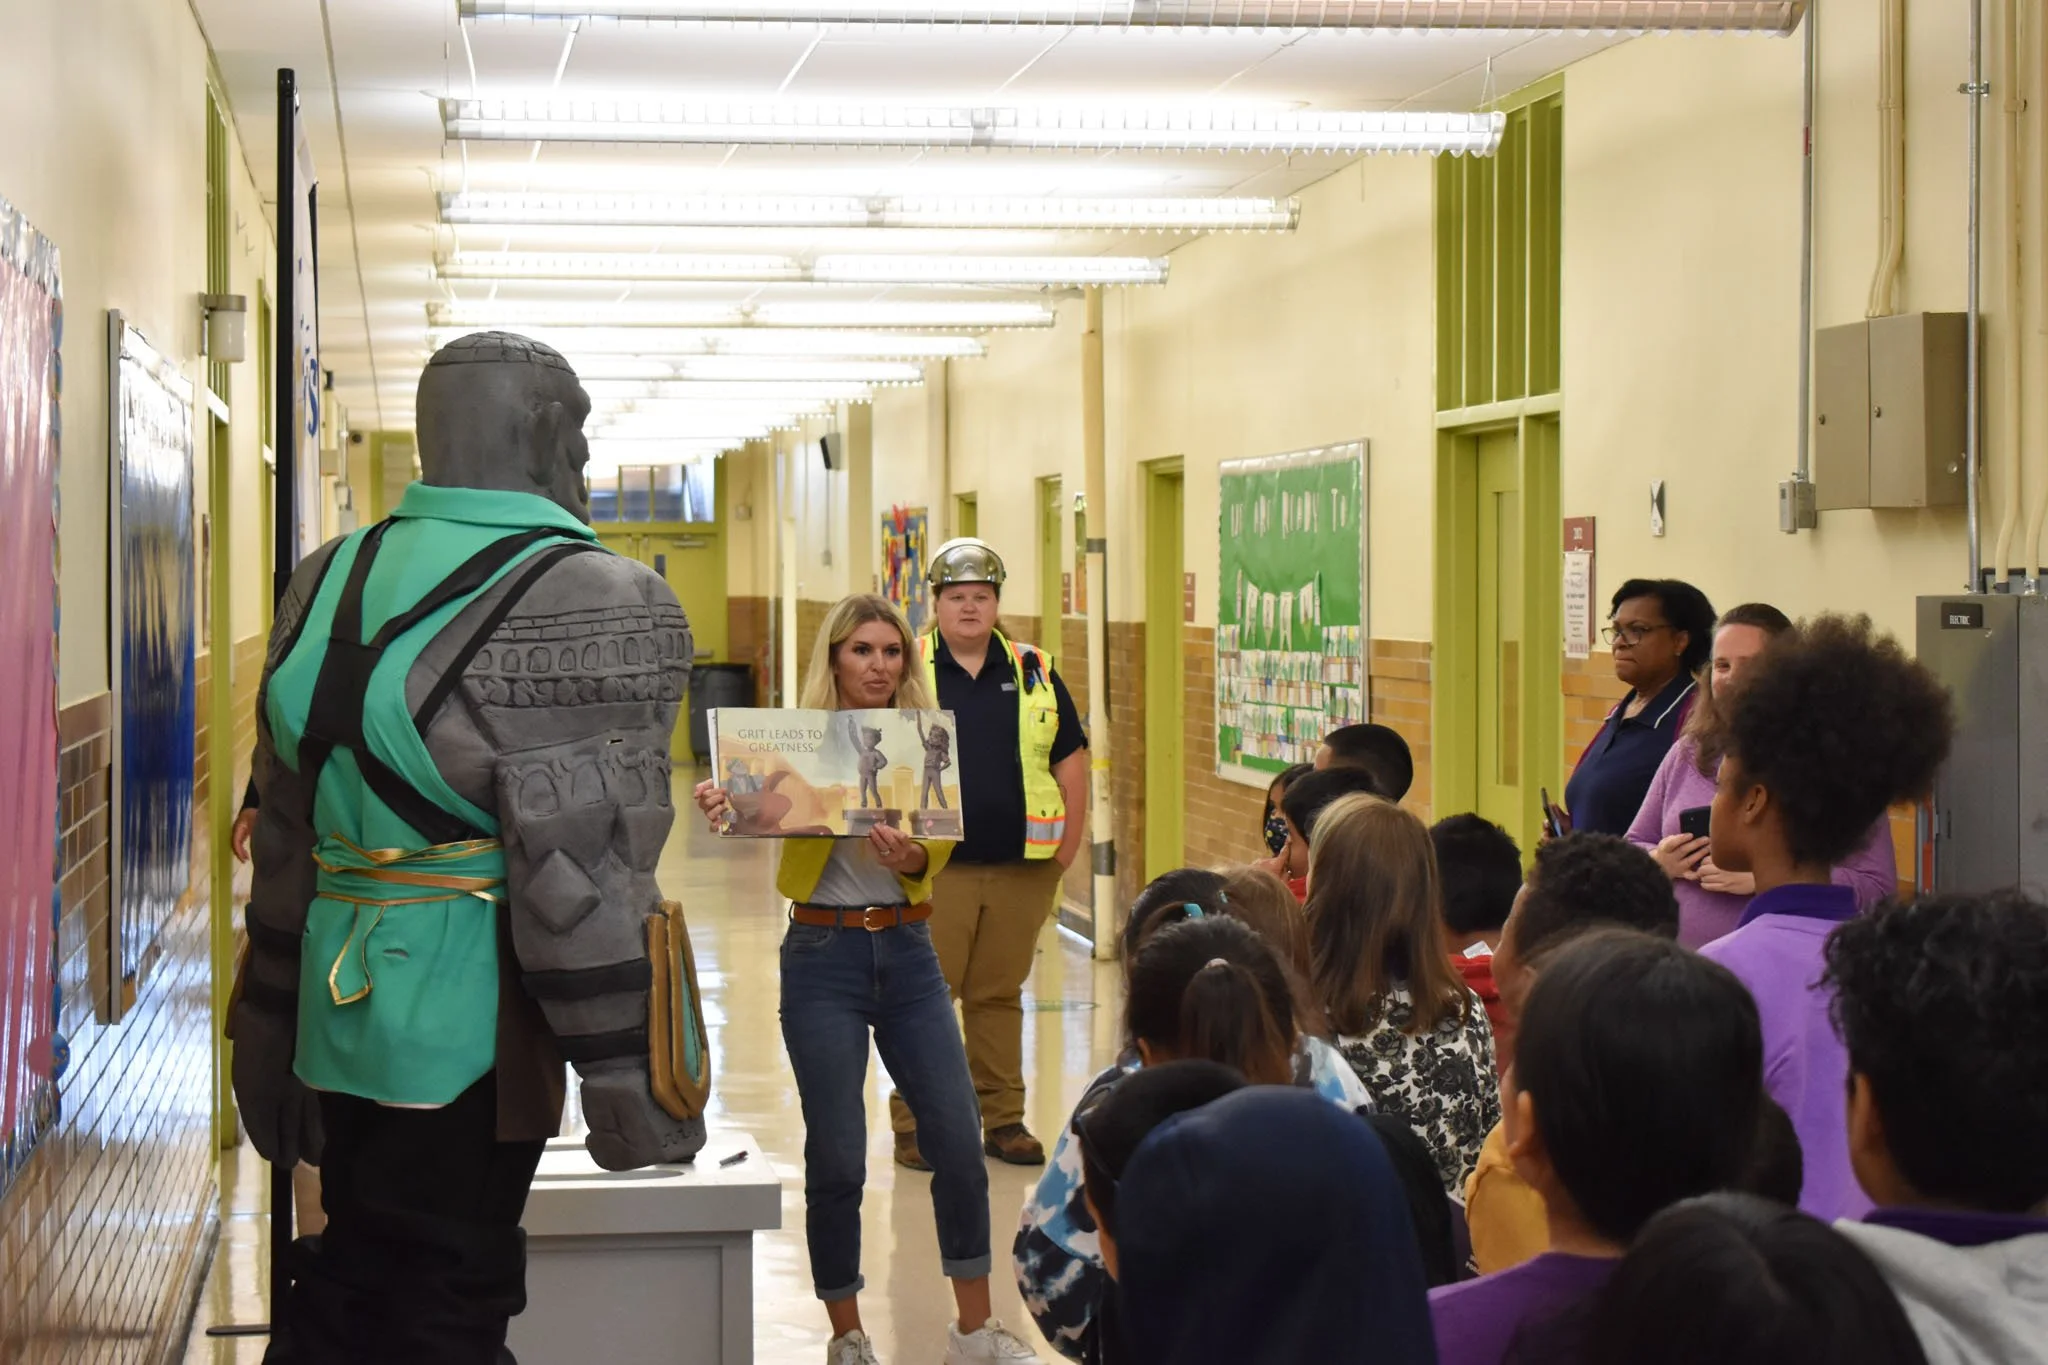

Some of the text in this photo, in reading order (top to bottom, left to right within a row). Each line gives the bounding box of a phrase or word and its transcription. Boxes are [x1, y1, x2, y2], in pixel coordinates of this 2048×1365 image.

[738, 729, 822, 740] GRIT LEADS TO
[749, 742, 814, 753] GREATNESS
